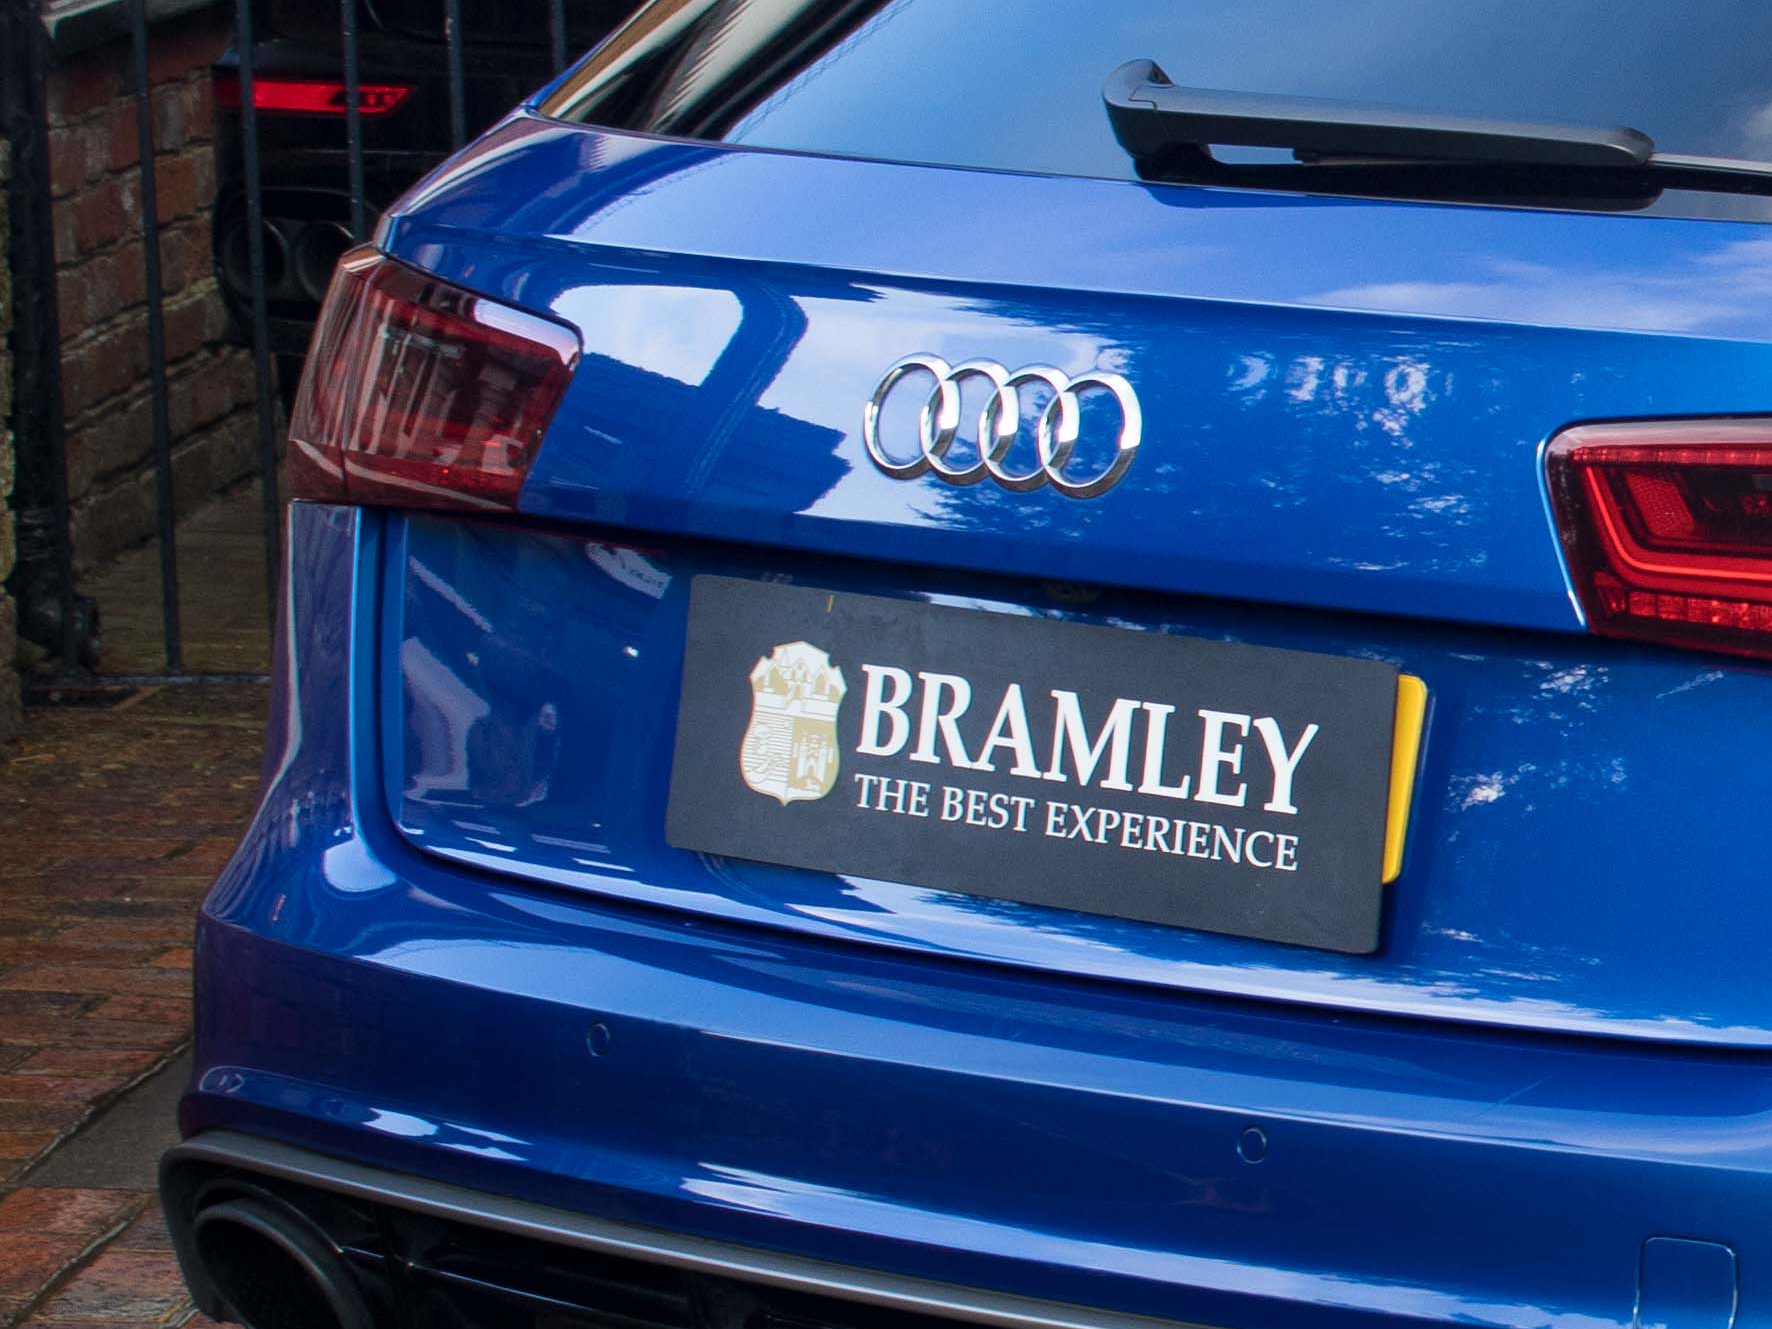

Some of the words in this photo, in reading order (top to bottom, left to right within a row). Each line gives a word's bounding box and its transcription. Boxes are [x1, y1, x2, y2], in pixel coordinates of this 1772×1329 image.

[856, 664, 1319, 814] BRAMLEY
[854, 773, 931, 818] THE
[941, 786, 1035, 833] BEST
[1045, 801, 1300, 871] EXPERIENCE
